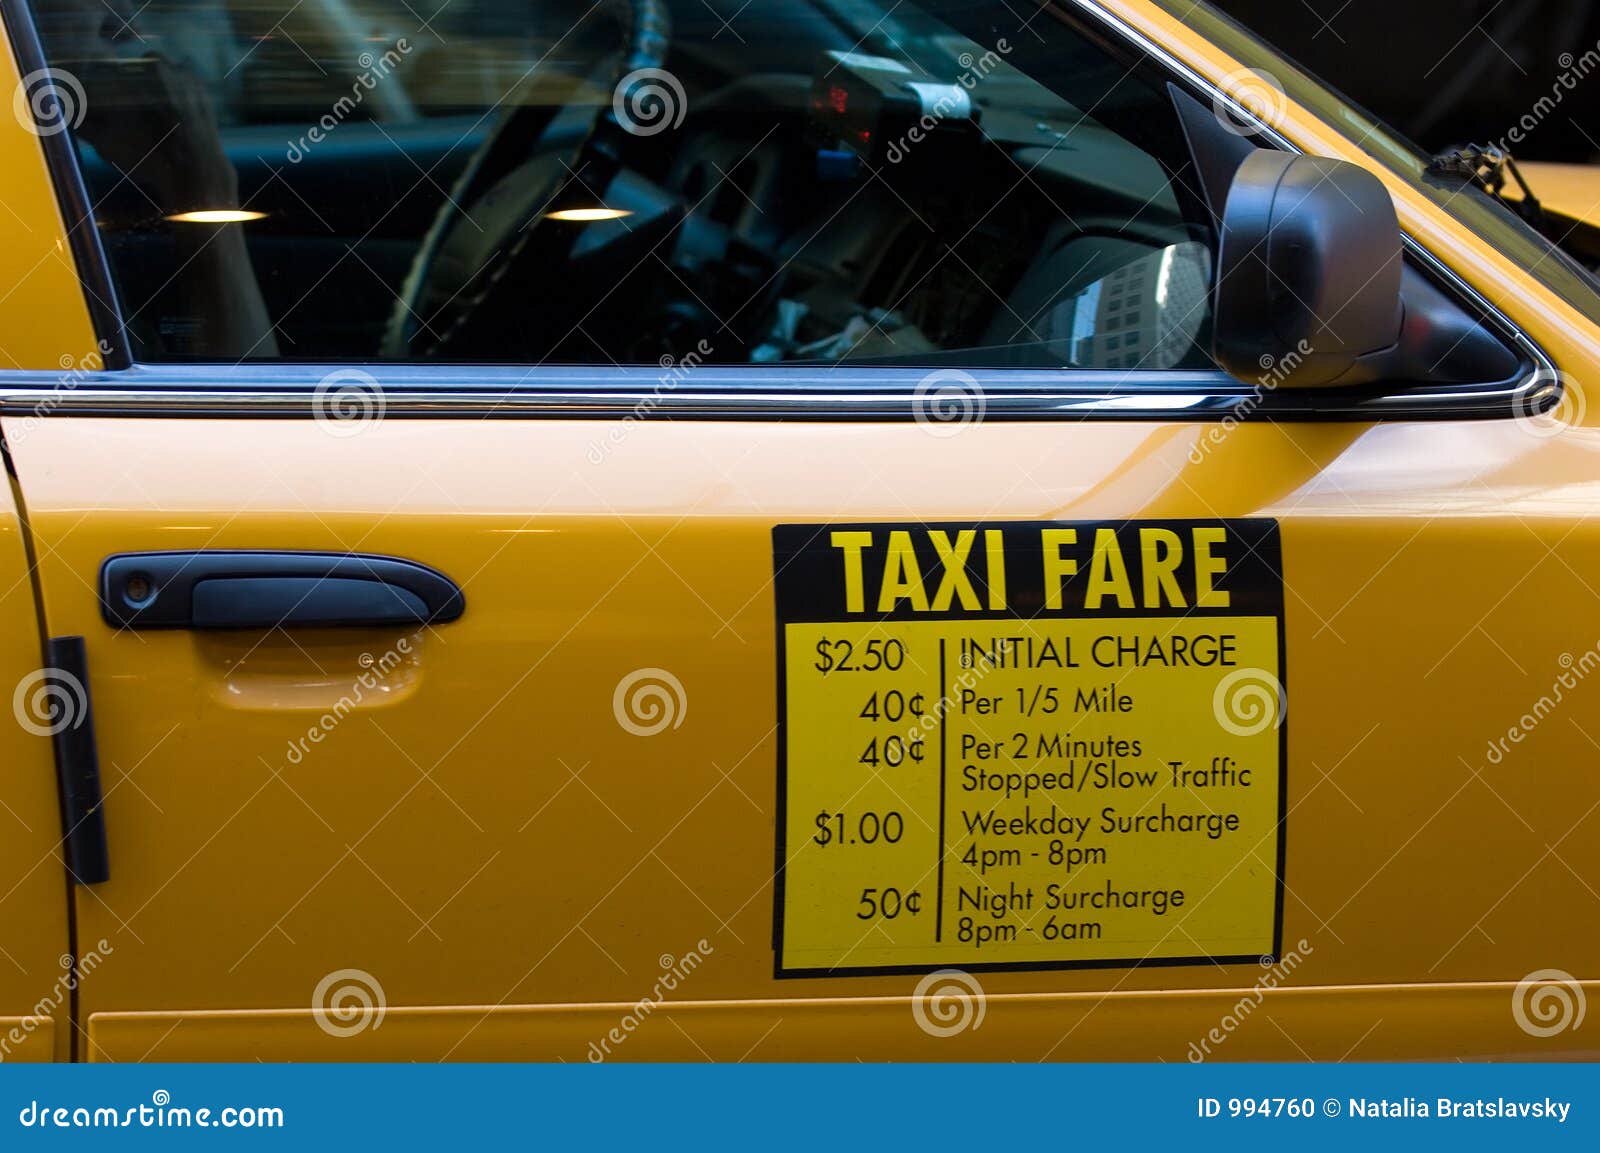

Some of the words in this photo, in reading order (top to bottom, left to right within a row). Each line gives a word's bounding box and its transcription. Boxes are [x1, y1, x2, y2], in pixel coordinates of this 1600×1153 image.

[831, 528, 1008, 613] TAXI
[1040, 527, 1231, 610] FARE
[814, 636, 905, 676] $2.50
[961, 636, 1079, 669] INITIAL
[1091, 634, 1237, 668] CHARGE
[858, 689, 925, 723] 40¢
[962, 688, 1004, 714] Per
[1016, 686, 1060, 718] 1/5
[1074, 684, 1134, 714] Mile
[858, 735, 925, 767] 40¢
[962, 733, 1005, 760] Per
[1012, 732, 1029, 759] 2
[1036, 732, 1142, 759] Minutes
[962, 762, 1158, 798] Stopped/Slow
[1168, 756, 1252, 789] Traffic
[813, 810, 905, 848] $1.00
[962, 806, 1091, 842] Weekday
[1100, 803, 1240, 840] Surcharge
[961, 842, 1021, 873] 4pm
[1048, 840, 1107, 874] 8pm
[856, 887, 922, 921] 50¢
[958, 882, 1034, 919] Night
[1045, 880, 1185, 916] Surcharge
[957, 917, 1017, 948] 8pm
[1042, 914, 1102, 941] 6am
